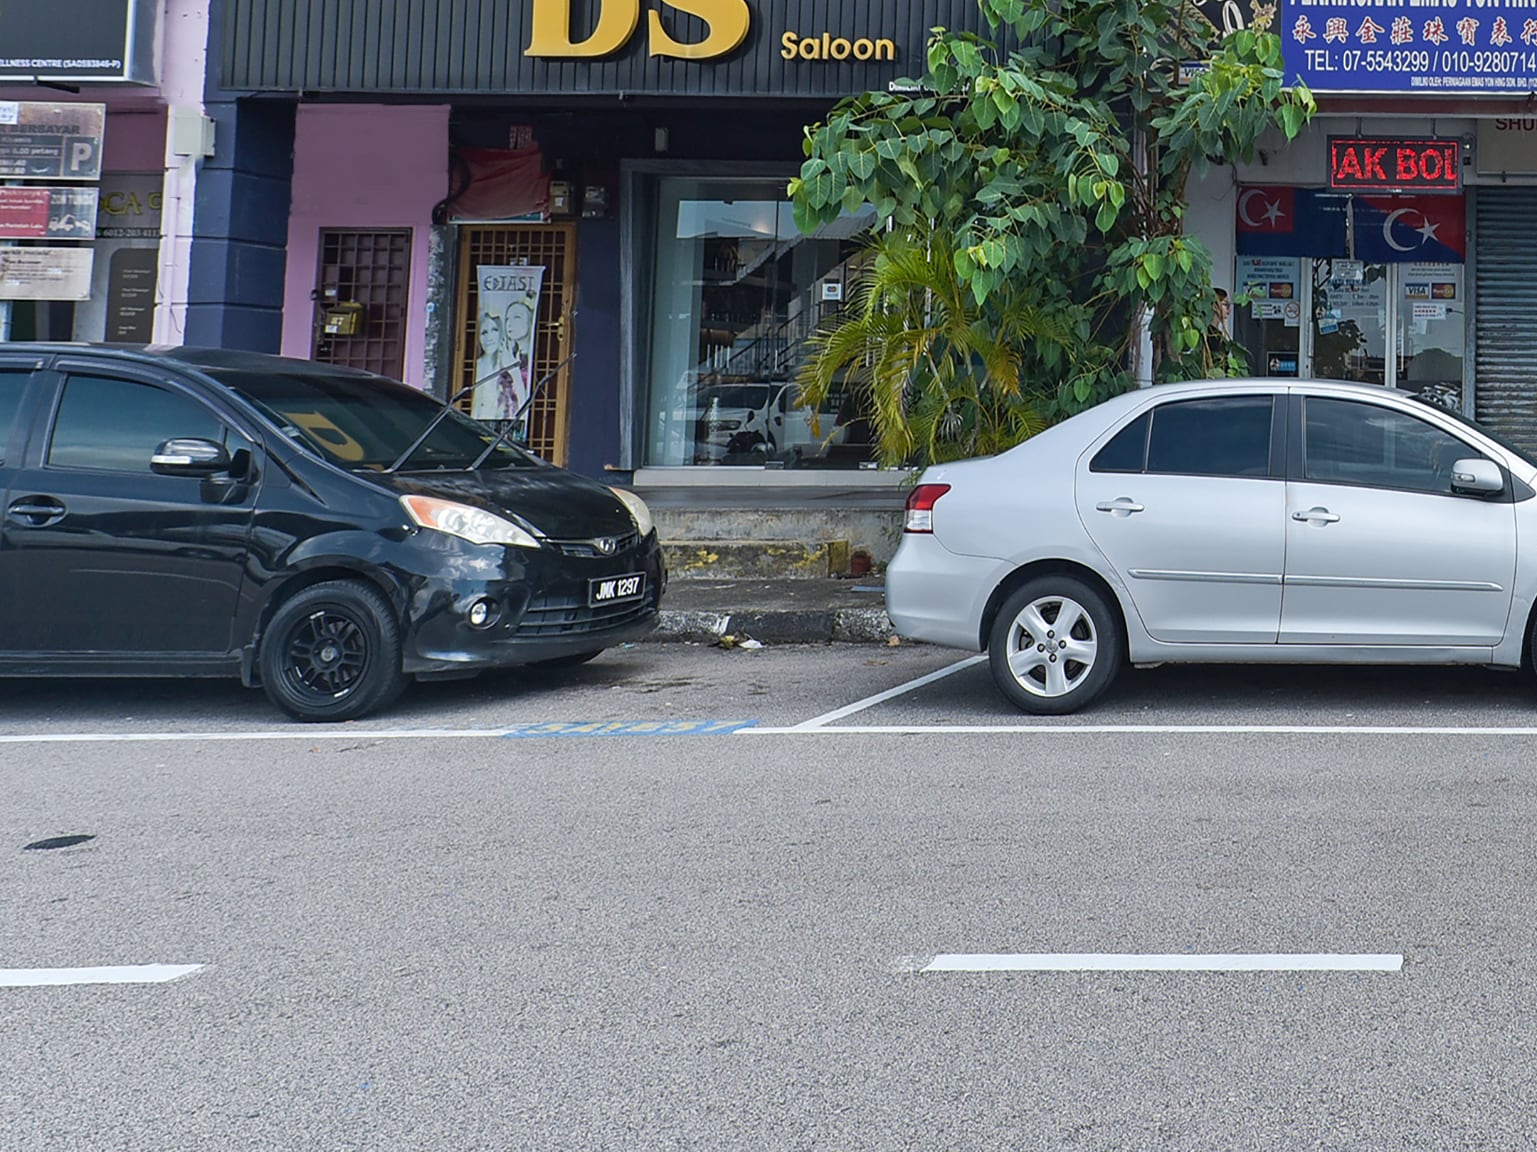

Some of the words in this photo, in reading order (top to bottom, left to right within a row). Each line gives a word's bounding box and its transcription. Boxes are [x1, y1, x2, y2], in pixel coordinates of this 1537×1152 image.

[781, 31, 895, 61] Saloon
[31, 59, 62, 68] CENTRE
[1304, 50, 1338, 72] TEL:
[1342, 50, 1429, 73] 07-5543299
[1432, 51, 1438, 72] /
[1442, 51, 1537, 73] 010-9280714
[71, 143, 92, 171] P
[596, 580, 617, 600] JMK
[617, 577, 640, 597] 1297
